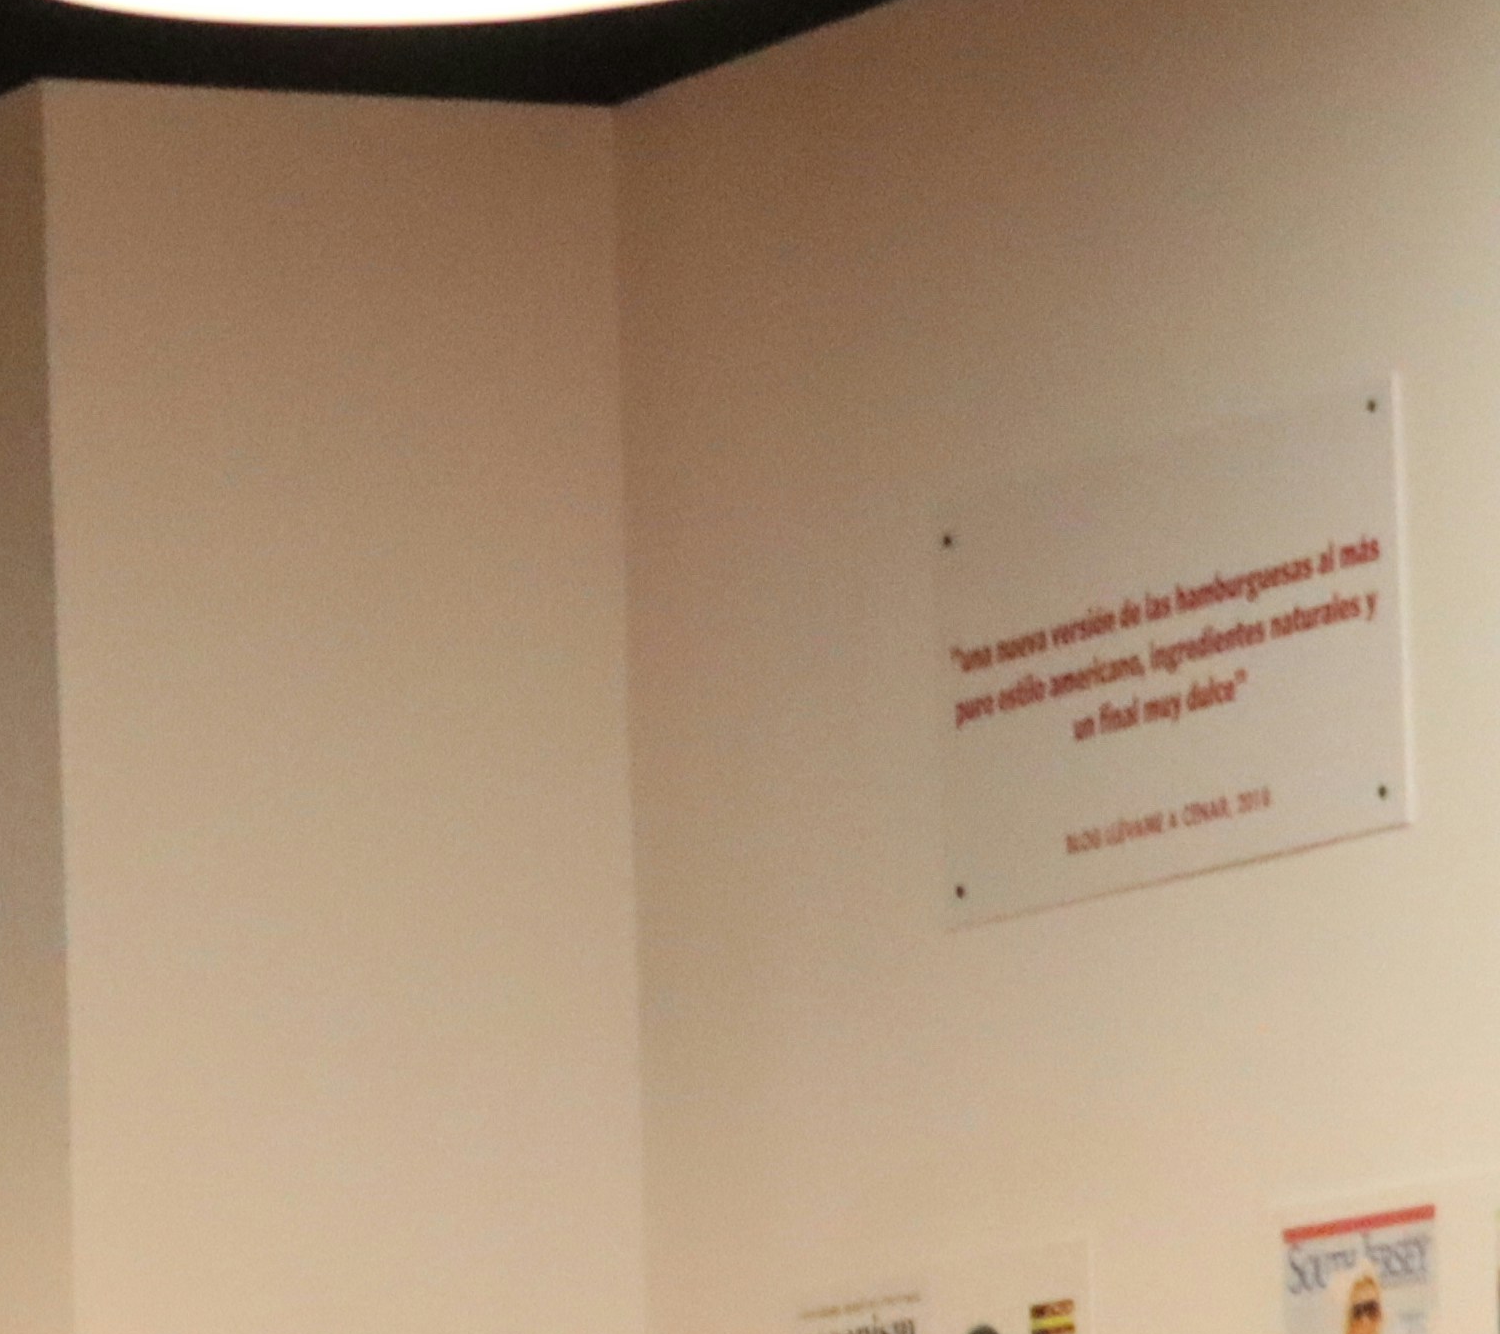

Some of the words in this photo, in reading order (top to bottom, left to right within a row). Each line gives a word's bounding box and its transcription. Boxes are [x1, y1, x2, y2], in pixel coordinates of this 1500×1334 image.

[1119, 599, 1141, 628] de
[1145, 592, 1171, 620] las
[1175, 558, 1313, 612] hamburguesas
[1339, 534, 1380, 567] más
[1150, 621, 1266, 674] ingredientes
[1270, 592, 1361, 639] naturales
[1367, 591, 1378, 620] y
[1073, 716, 1095, 741] un
[1143, 695, 1181, 726] muy
